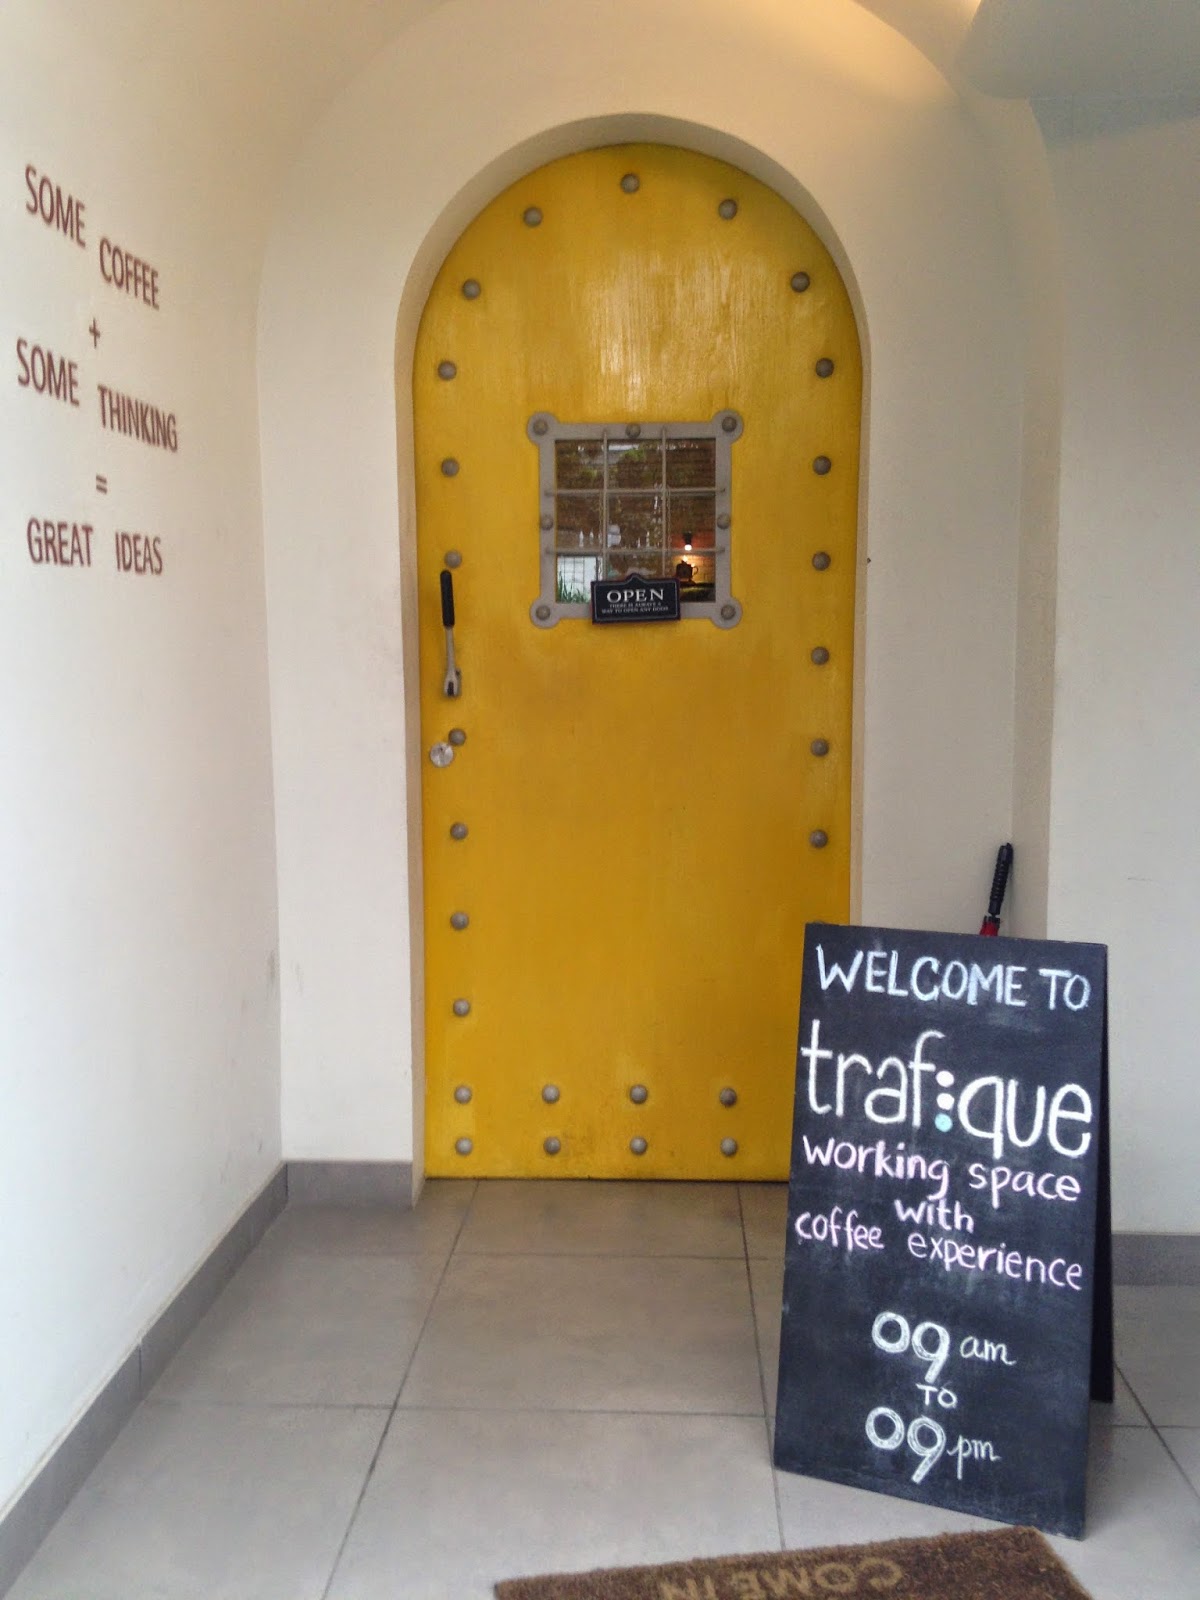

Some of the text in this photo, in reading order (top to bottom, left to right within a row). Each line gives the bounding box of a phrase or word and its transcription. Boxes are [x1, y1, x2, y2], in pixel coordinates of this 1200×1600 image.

[24, 163, 160, 311] SOME COFFEE
[16, 337, 178, 453] SOME THINKING
[27, 516, 163, 576] GREAT IDEAS
[606, 588, 664, 603] OPEN
[816, 944, 1091, 1011] WELCOME TO
[803, 1135, 1081, 1209] working space
[794, 1206, 1083, 1291] coffee experience
[894, 1198, 974, 1233] with
[871, 1311, 1016, 1384] 09 am
[916, 1383, 957, 1408] TO
[865, 1406, 1001, 1485] 09 pm
[730, 1557, 902, 1600] COME
